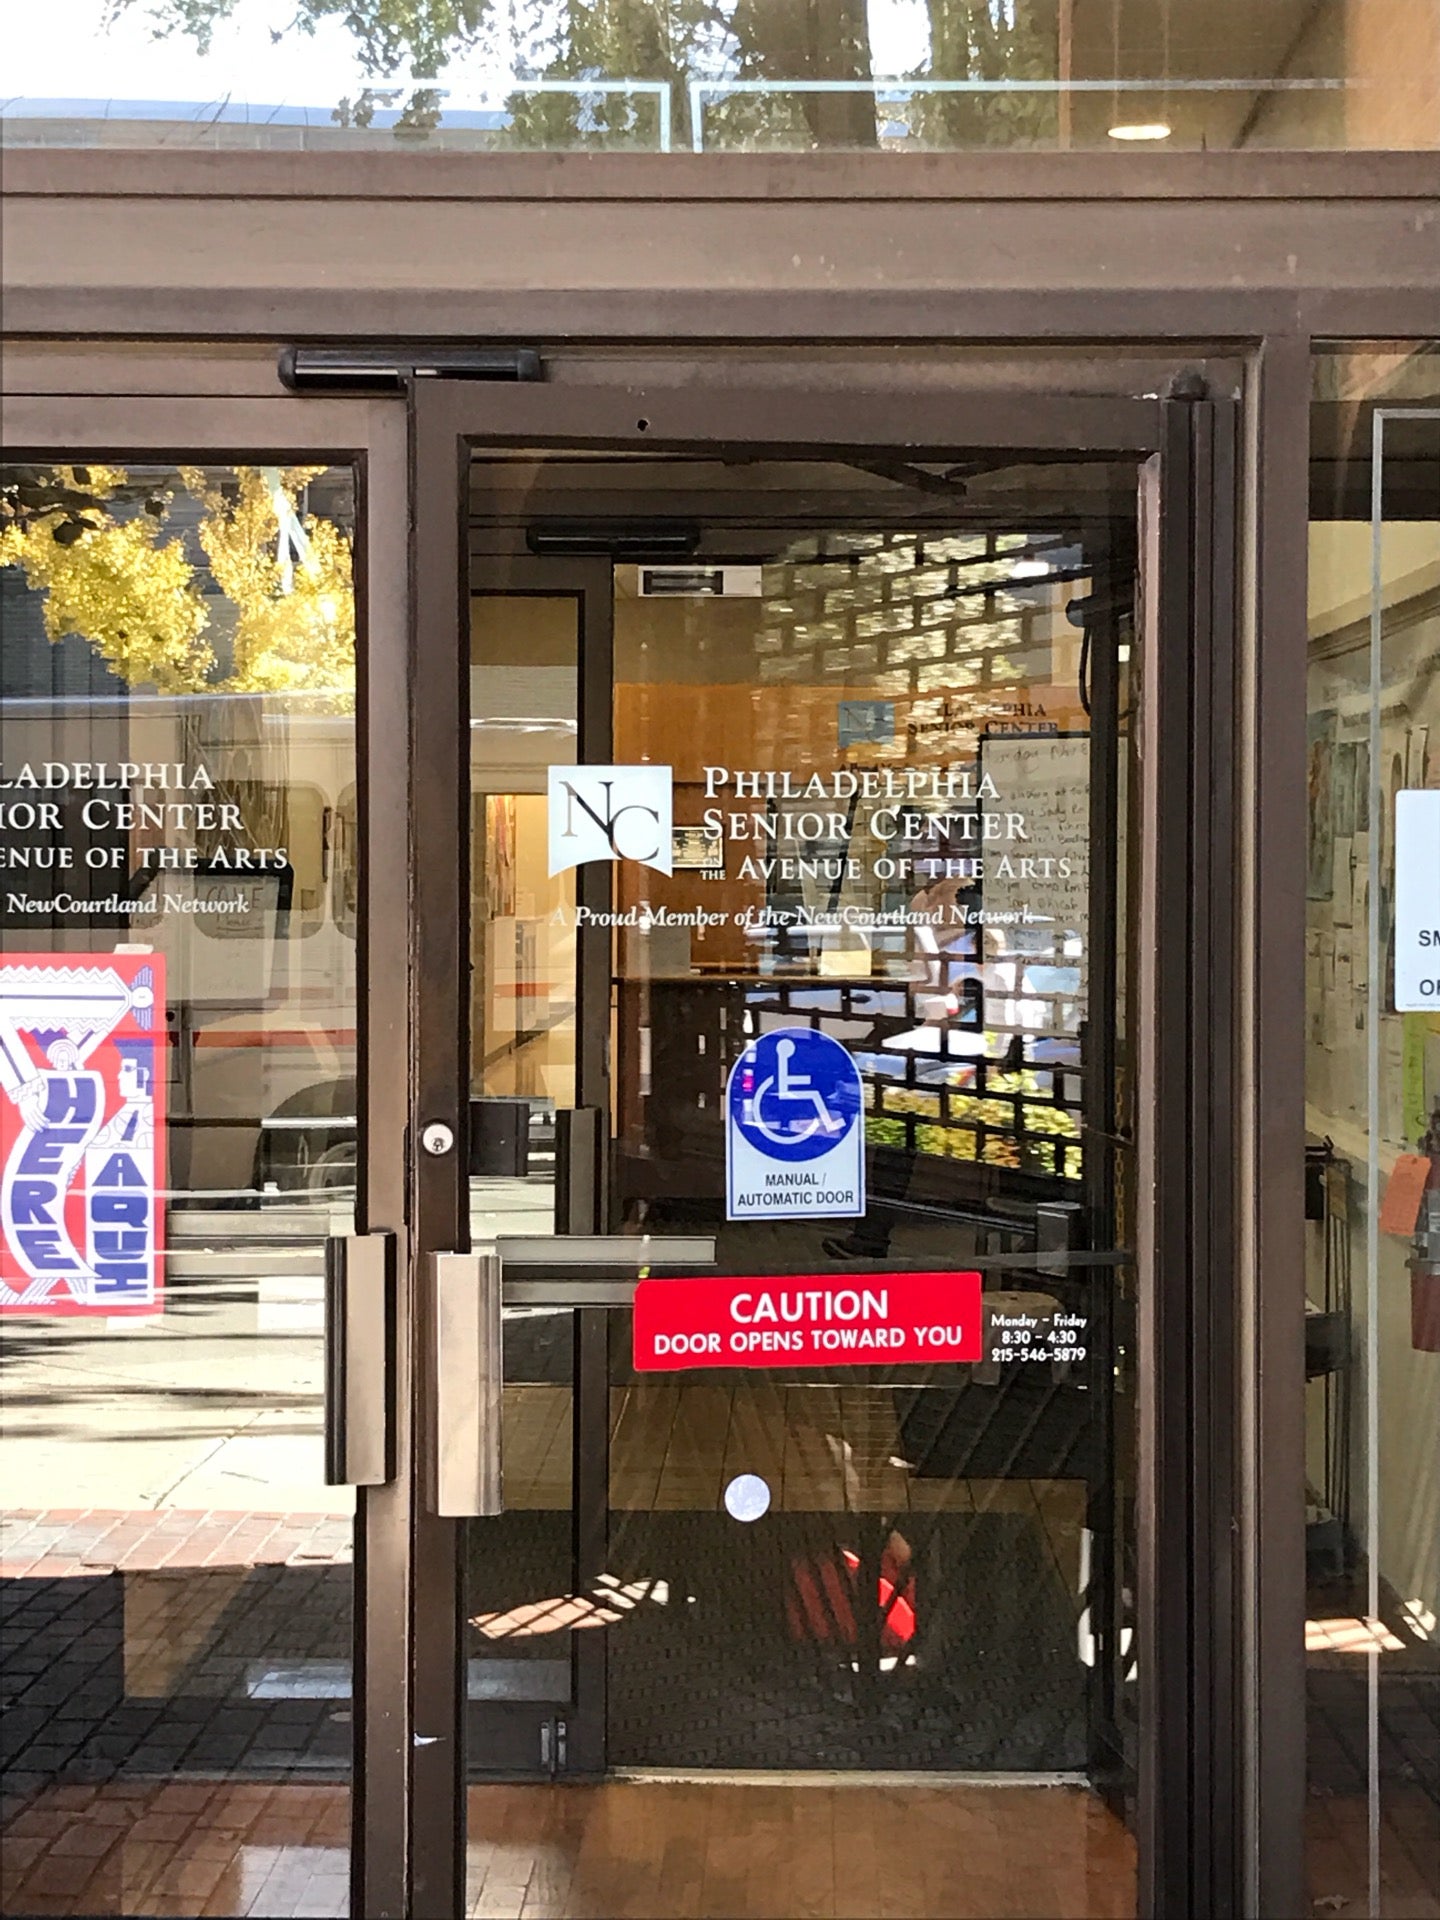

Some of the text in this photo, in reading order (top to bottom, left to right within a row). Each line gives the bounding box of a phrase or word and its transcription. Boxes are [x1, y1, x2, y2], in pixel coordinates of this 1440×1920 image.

[702, 766, 1002, 799] PHILADELPHIA
[81, 798, 245, 831] CENTER
[703, 808, 852, 841] SENIOR
[869, 808, 1029, 841] CENTER
[84, 847, 126, 869] OF
[136, 847, 199, 869] THE
[208, 846, 288, 870] ARTS
[699, 869, 727, 881] THE
[735, 855, 862, 881] AVENUE
[872, 857, 912, 880] OF
[923, 857, 985, 880] THE
[996, 854, 1072, 880] ARTS
[6, 892, 251, 915] NewCourtland Network
[549, 906, 567, 927] A
[575, 905, 637, 927] Proud
[645, 905, 729, 927] Member
[734, 905, 755, 929] of
[758, 905, 790, 926] the
[796, 905, 944, 926] NewCourtland
[950, 904, 1034, 926] Network
[10, 1077, 97, 1271] HERE
[765, 1172, 819, 1187] MANUAL
[737, 1190, 854, 1206] AUTOMATIC DOOR
[729, 1289, 889, 1324] CAUTION
[990, 1313, 1038, 1329] Monday
[1053, 1313, 1088, 1329] Friday
[653, 1325, 963, 1355] DOOR OPENS TOWARD YOU
[1001, 1330, 1031, 1345] 8:30
[1047, 1330, 1077, 1345] 4:30
[991, 1347, 1087, 1363] 215-546-5879
